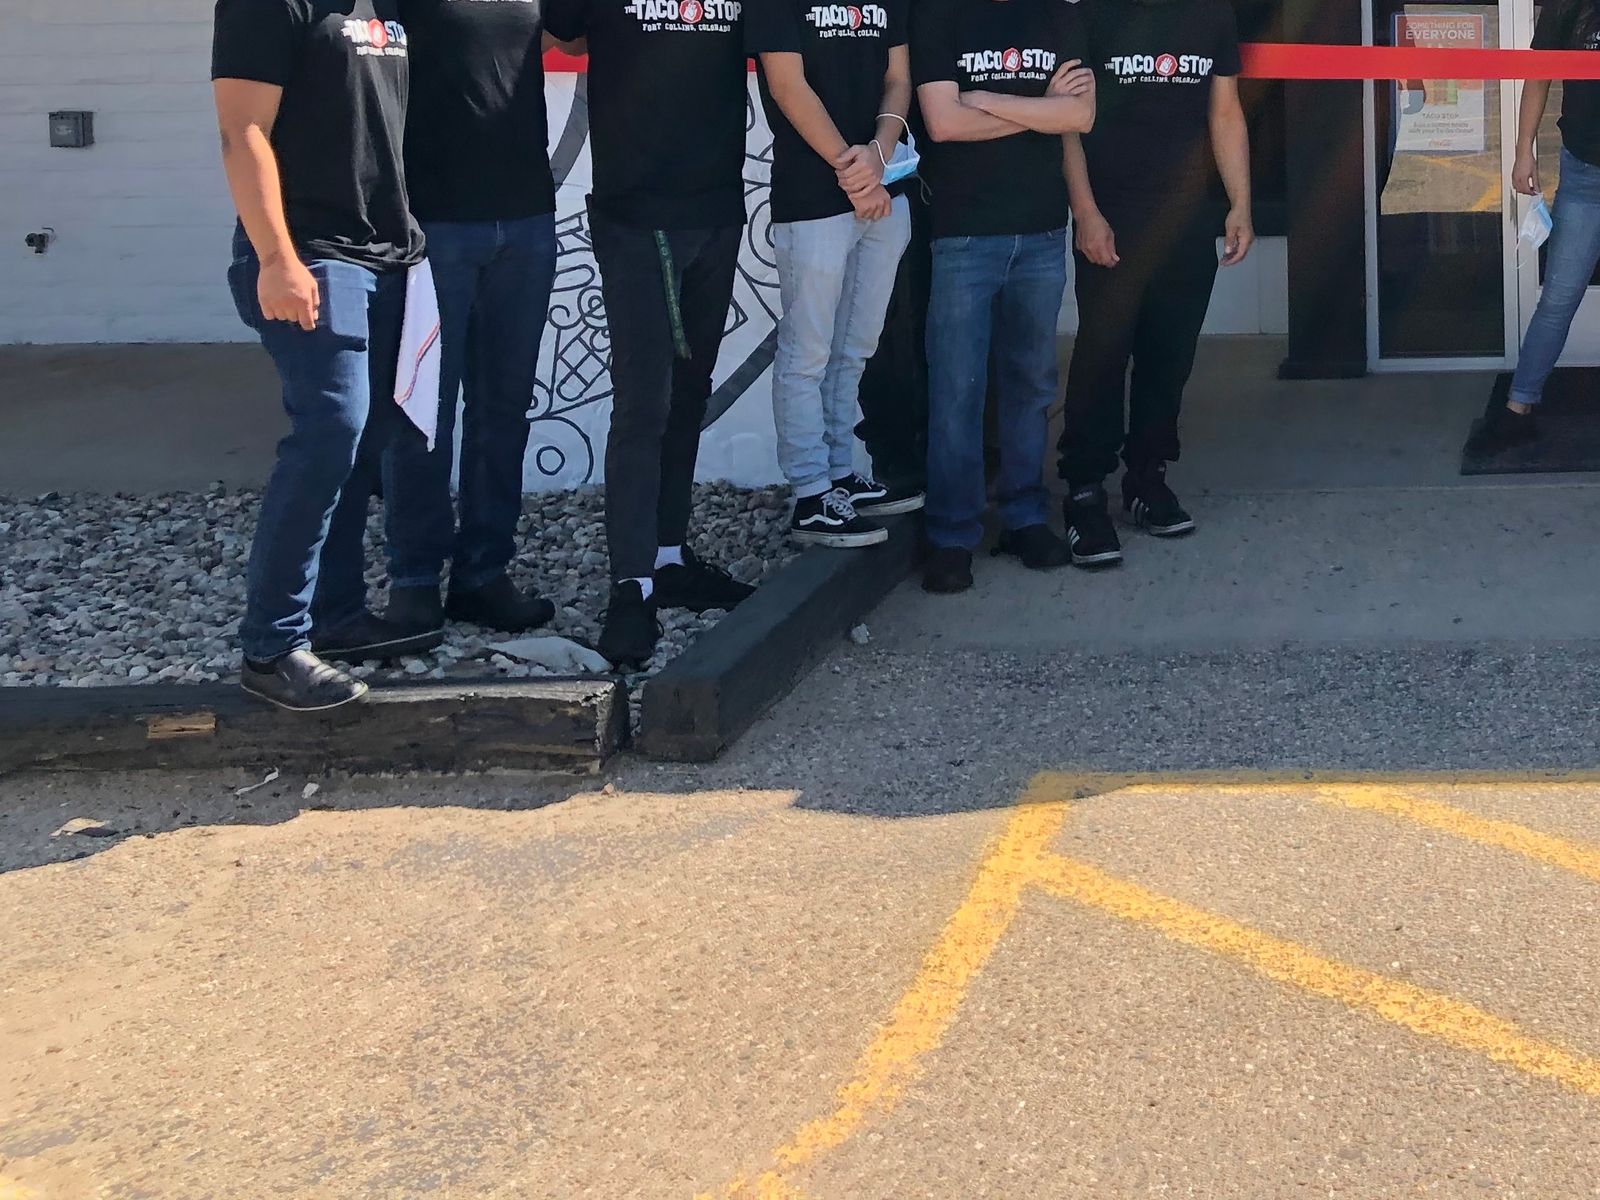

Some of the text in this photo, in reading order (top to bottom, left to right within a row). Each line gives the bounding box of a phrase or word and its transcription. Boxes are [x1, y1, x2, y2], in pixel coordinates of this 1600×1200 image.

[703, 0, 742, 21] STOP
[811, 4, 849, 28] TACO
[642, 23, 662, 32] FORT
[699, 23, 731, 32] COLORADO
[1405, 30, 1476, 40] EVERYONE
[962, 50, 1003, 73] TACO
[1111, 54, 1155, 75] TACO
[1179, 54, 1214, 76] STOP
[970, 73, 989, 82] FORT
[1119, 76, 1137, 84] FORT
